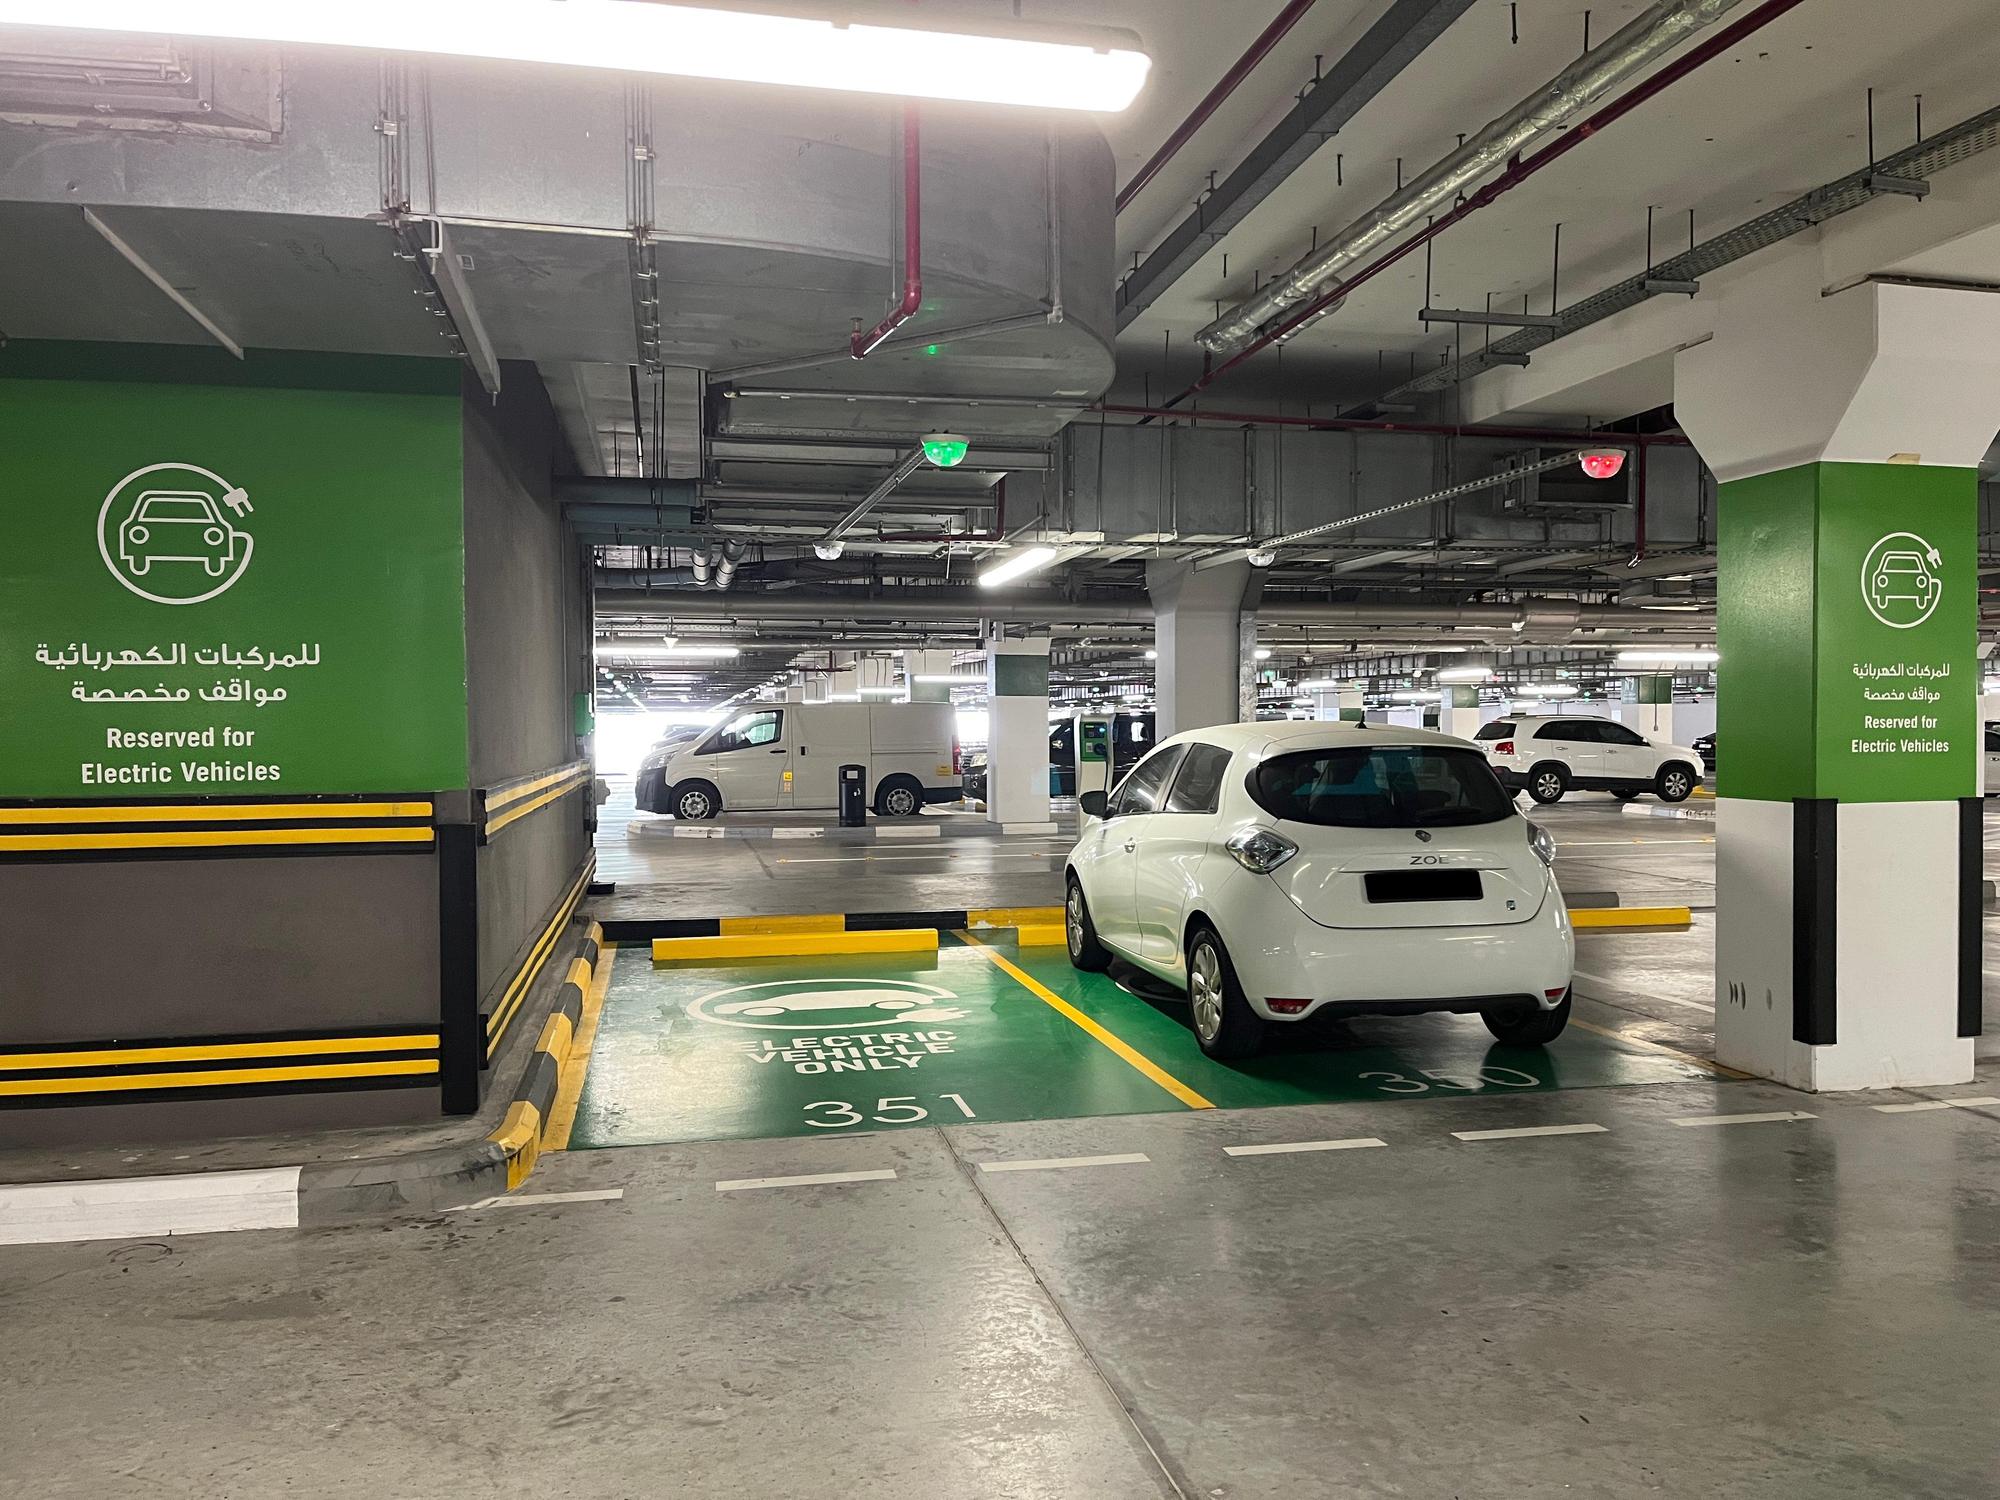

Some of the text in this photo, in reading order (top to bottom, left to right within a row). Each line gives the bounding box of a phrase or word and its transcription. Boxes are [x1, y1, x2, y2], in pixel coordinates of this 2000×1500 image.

[35, 642, 320, 672] للمركبات الكهربائية
[1852, 663, 1950, 680] للمركبات الكهربائية
[71, 678, 287, 708] مواقف مخصصة
[1863, 686, 1941, 704] مواقف مخصصة
[1864, 714, 1938, 729] Reserved for
[107, 726, 255, 748] Reserved for
[1851, 738, 1949, 753] Electric Vehicles
[81, 760, 281, 784] Electric Vehicles
[1409, 855, 1450, 866] ZOE
[737, 1030, 958, 1052] ELECTRIC
[746, 1041, 956, 1064] VEHICLE
[794, 1055, 923, 1075] ONLY
[1358, 1066, 1541, 1093] 350
[802, 1093, 977, 1128] 351
